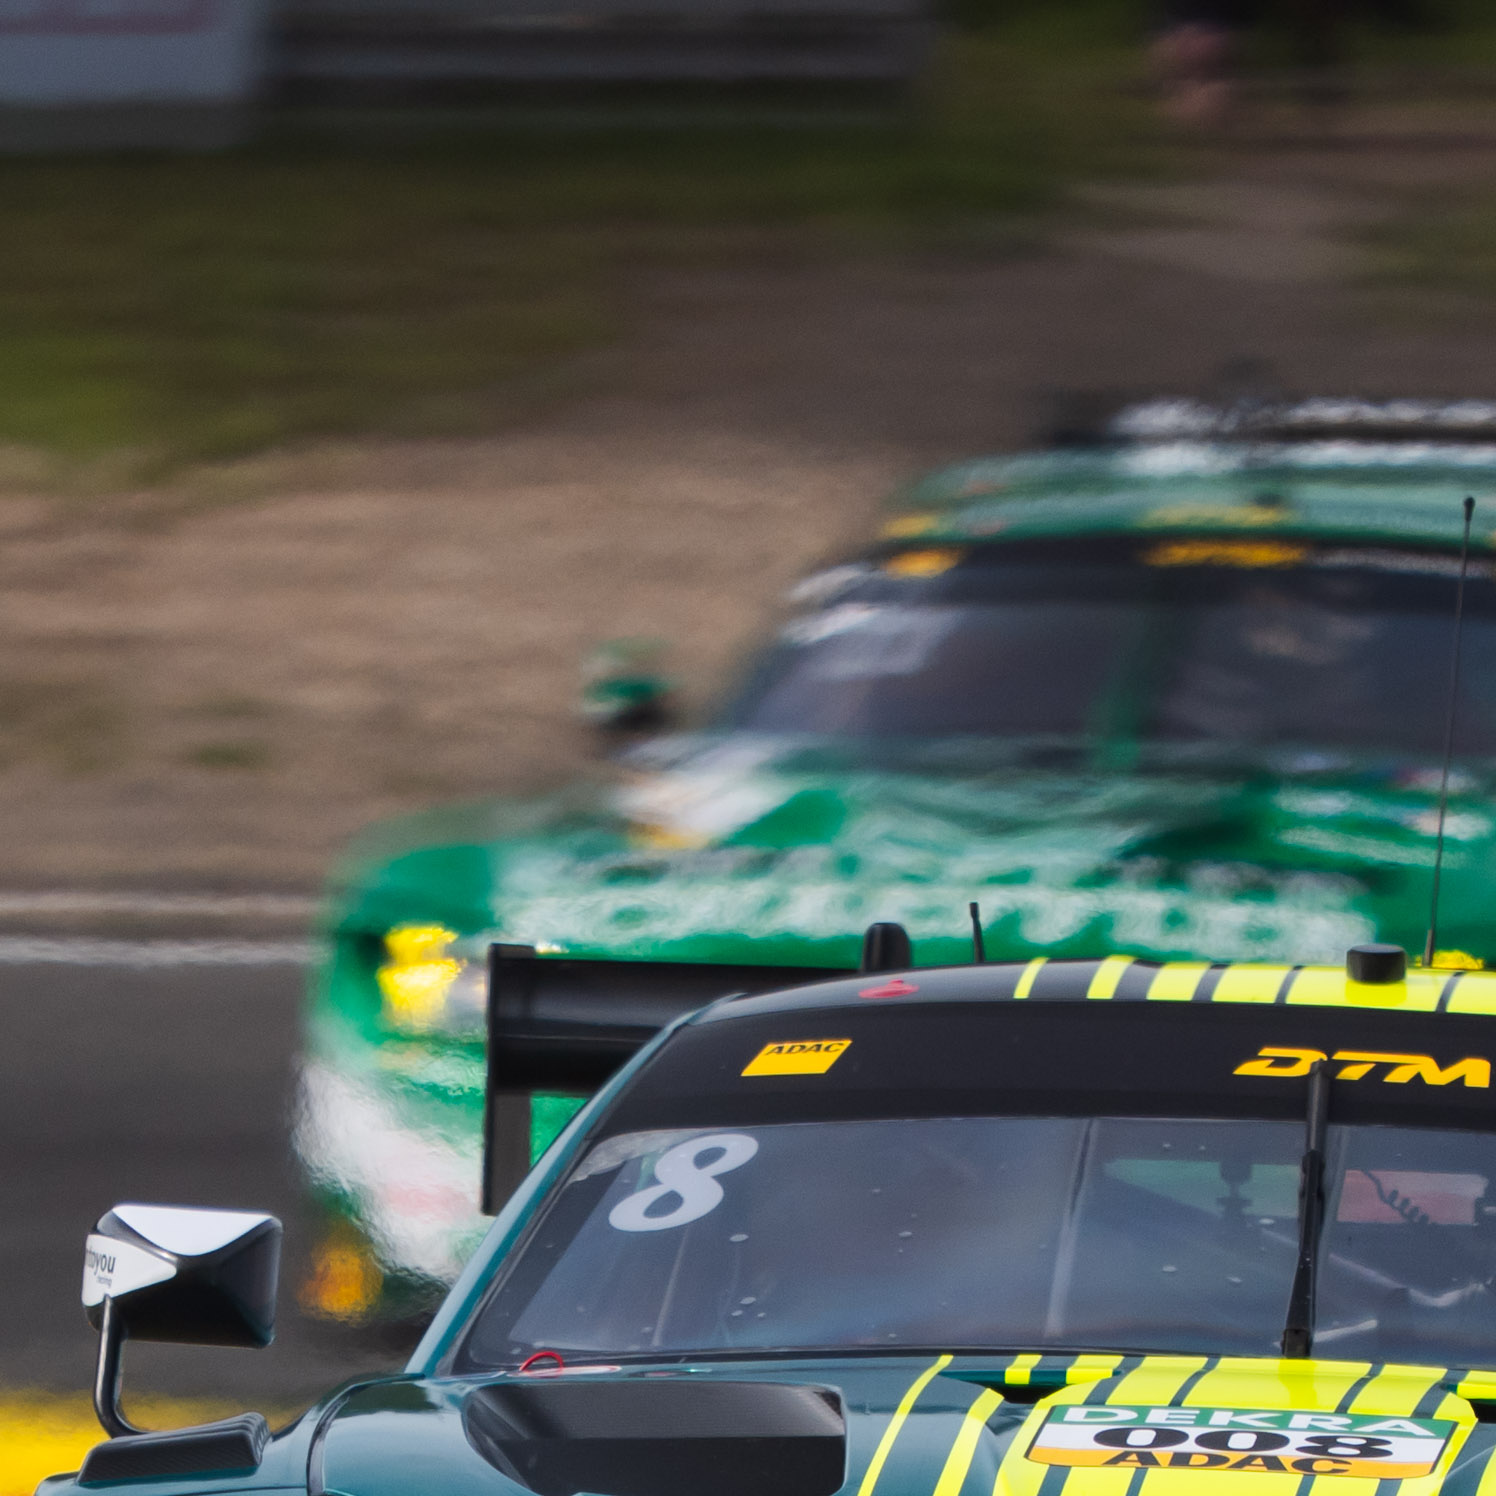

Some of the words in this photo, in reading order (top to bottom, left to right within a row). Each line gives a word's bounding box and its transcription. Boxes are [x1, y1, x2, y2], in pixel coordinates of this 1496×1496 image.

[766, 1042, 844, 1055] ADAC
[1233, 1046, 1491, 1088] DTM
[608, 1132, 759, 1232] 8
[1062, 1406, 1438, 1438] DEKRA
[1092, 1427, 1394, 1459] 008
[1102, 1450, 1353, 1474] ADAC
